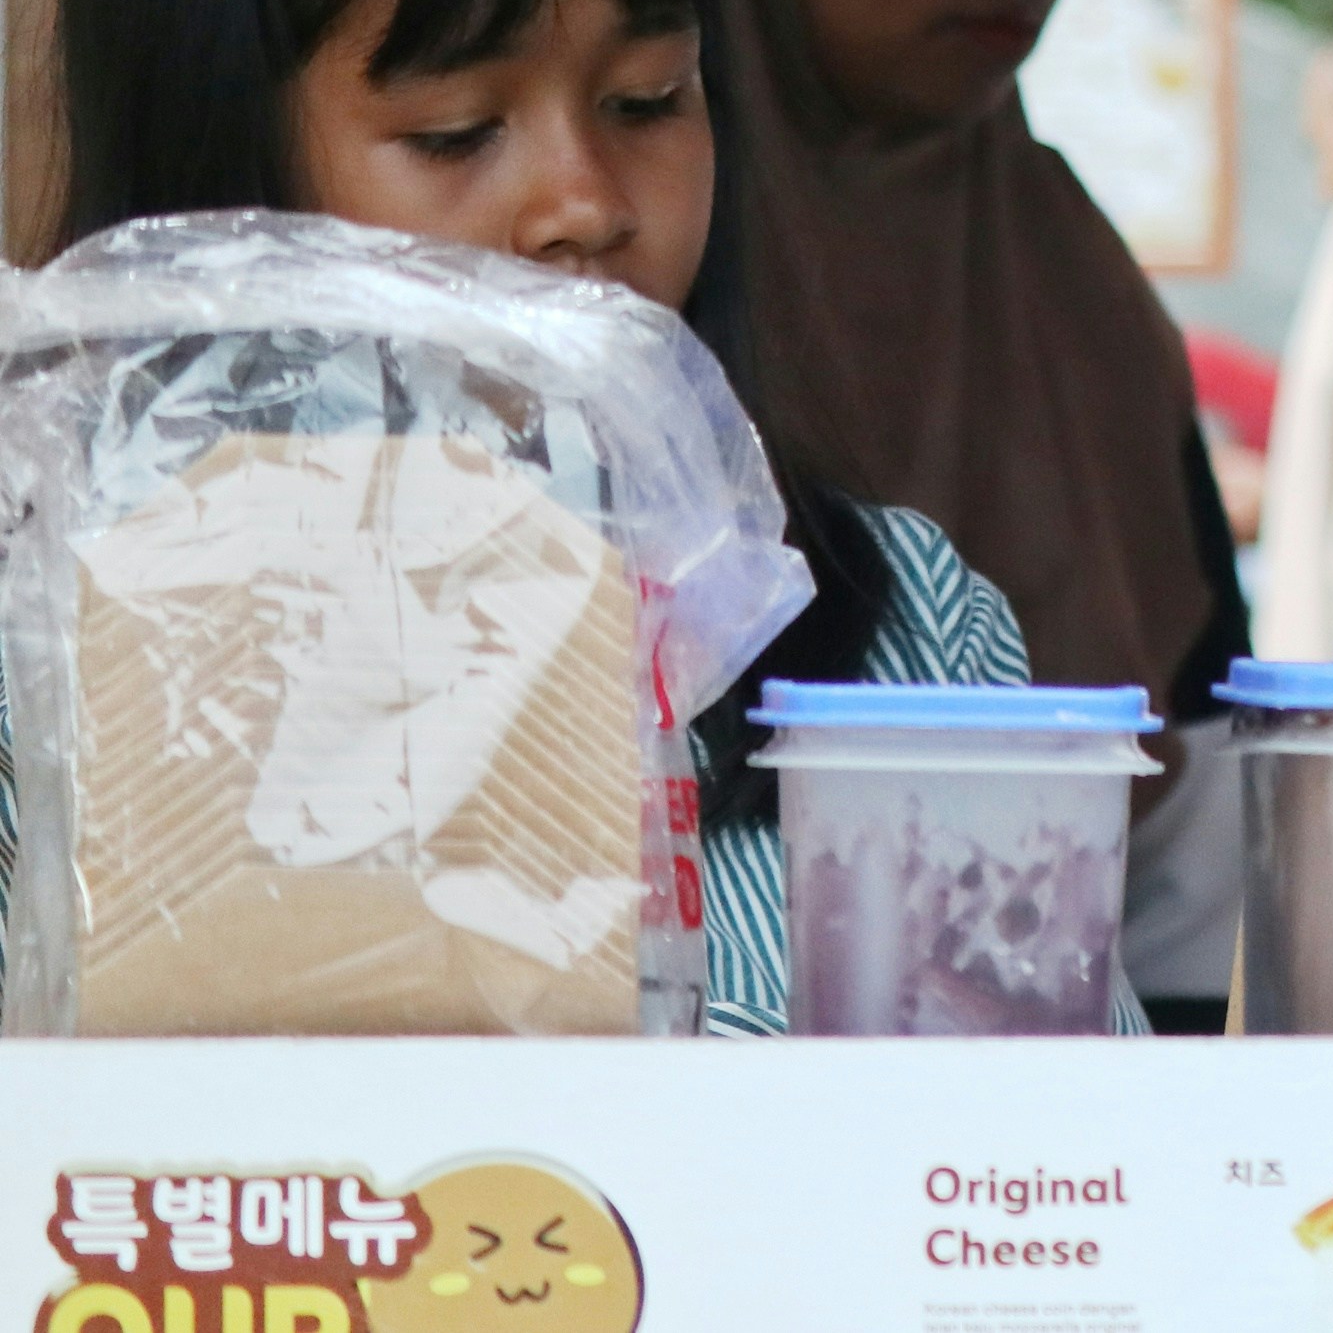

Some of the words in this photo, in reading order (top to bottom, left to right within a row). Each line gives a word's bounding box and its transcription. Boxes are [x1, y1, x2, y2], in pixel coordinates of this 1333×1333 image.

[926, 1166, 1128, 1215] Original
[61, 1175, 417, 1273] 특별메뉴
[927, 1227, 1100, 1267] Cheese
